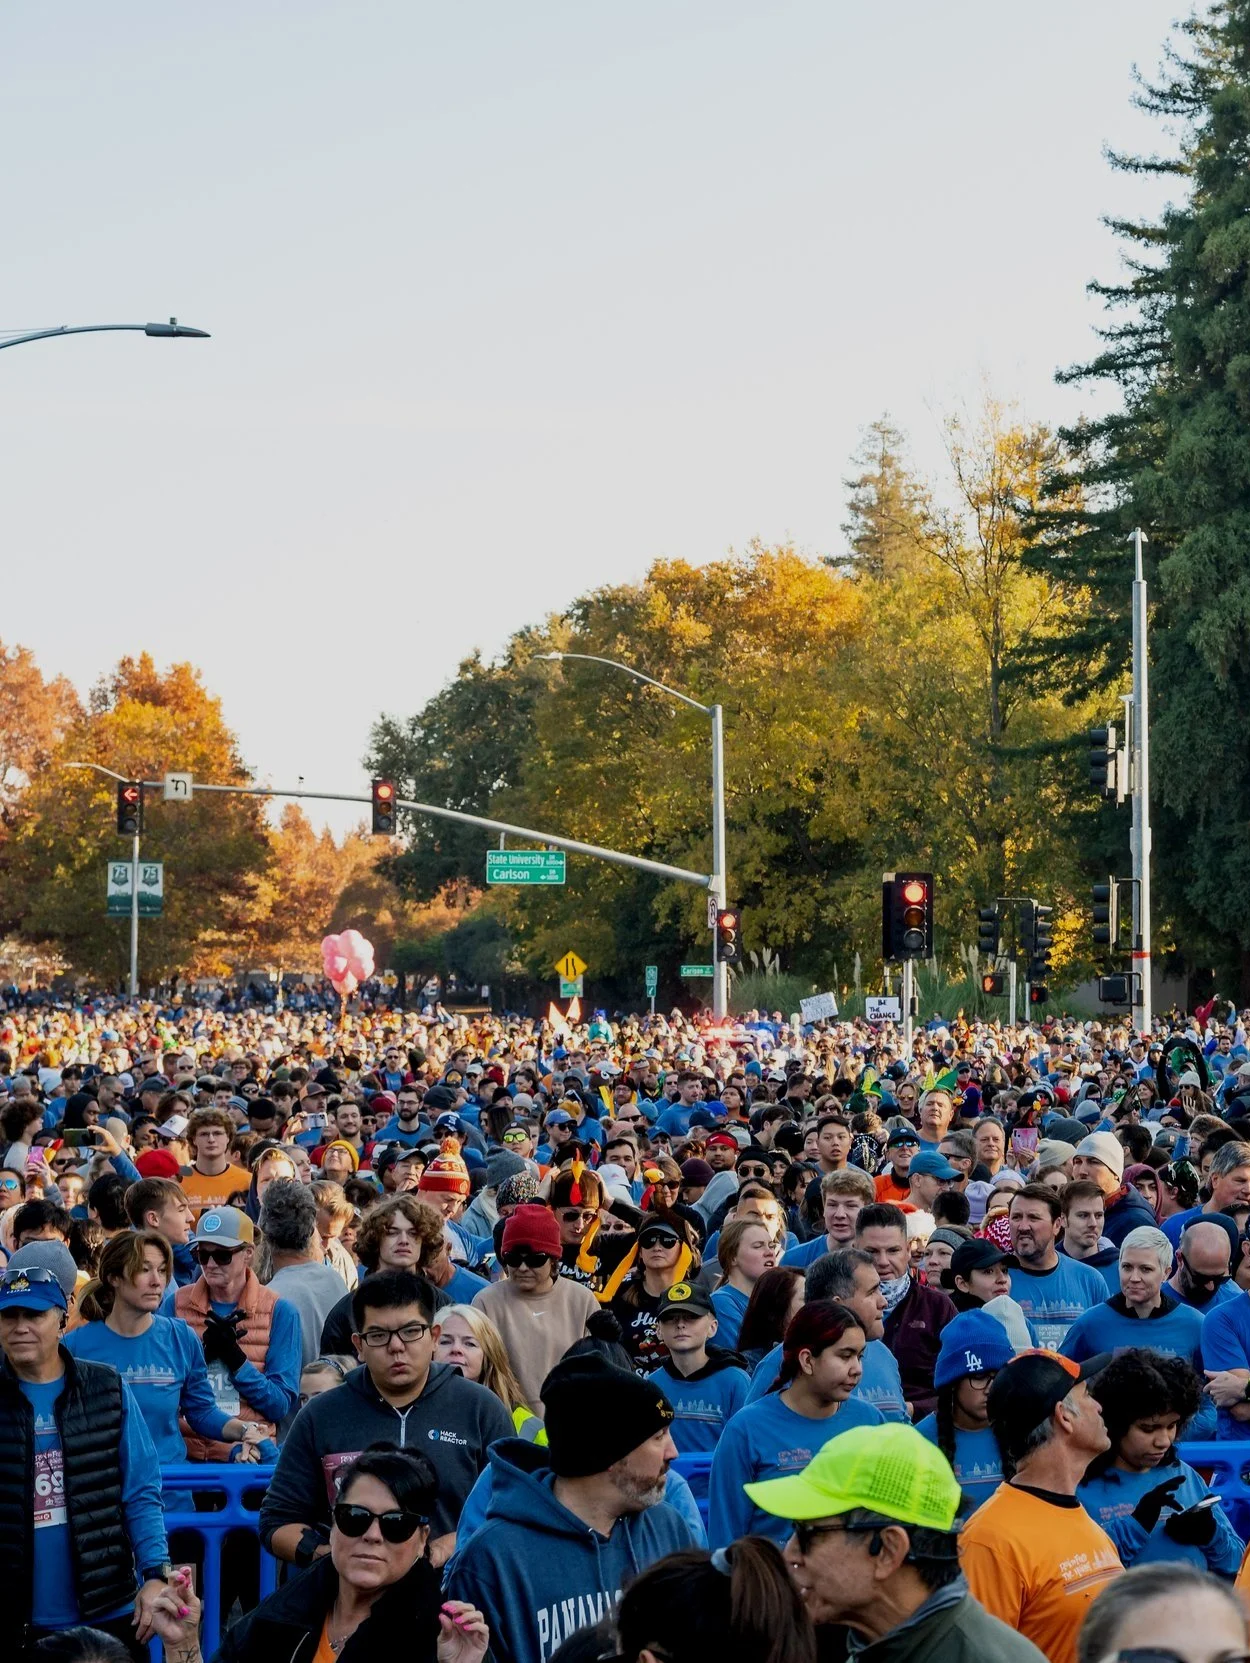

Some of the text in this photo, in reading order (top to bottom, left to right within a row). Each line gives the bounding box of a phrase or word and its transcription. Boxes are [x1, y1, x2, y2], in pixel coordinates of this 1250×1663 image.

[488, 854, 545, 867] State University
[114, 867, 126, 878] 75
[144, 867, 157, 878] 75
[492, 869, 530, 880] Carlson
[964, 1350, 983, 1371] LA
[440, 1430, 457, 1439] HACK
[440, 1436, 468, 1446] REACTOR
